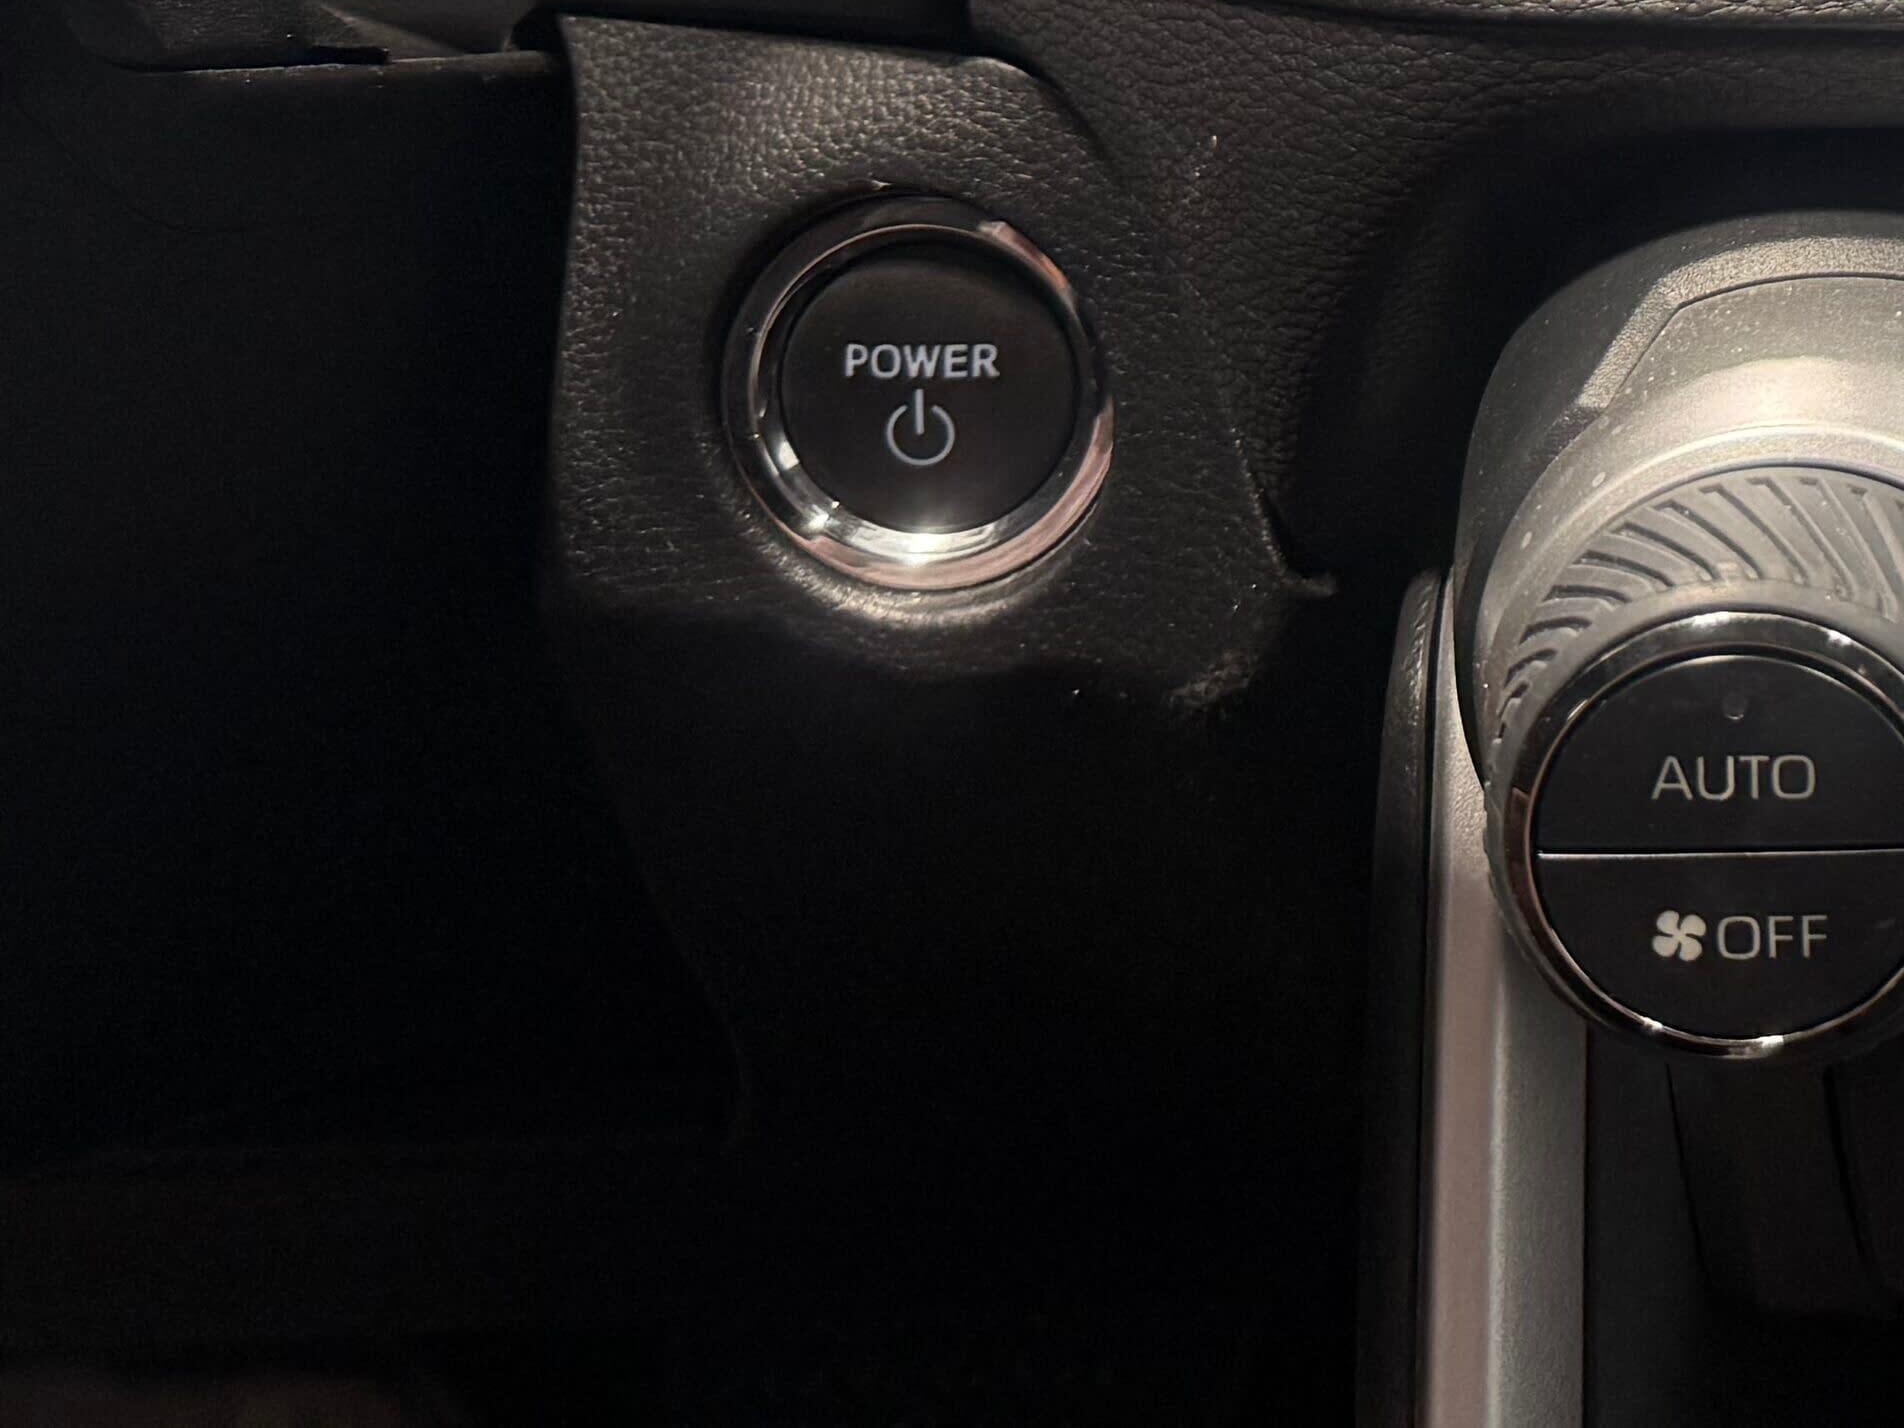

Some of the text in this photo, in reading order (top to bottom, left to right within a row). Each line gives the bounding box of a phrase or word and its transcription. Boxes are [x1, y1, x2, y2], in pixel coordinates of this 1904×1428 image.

[845, 343, 999, 379] POWER
[1652, 754, 1816, 801] AUTO
[1717, 915, 1827, 960] OFF
